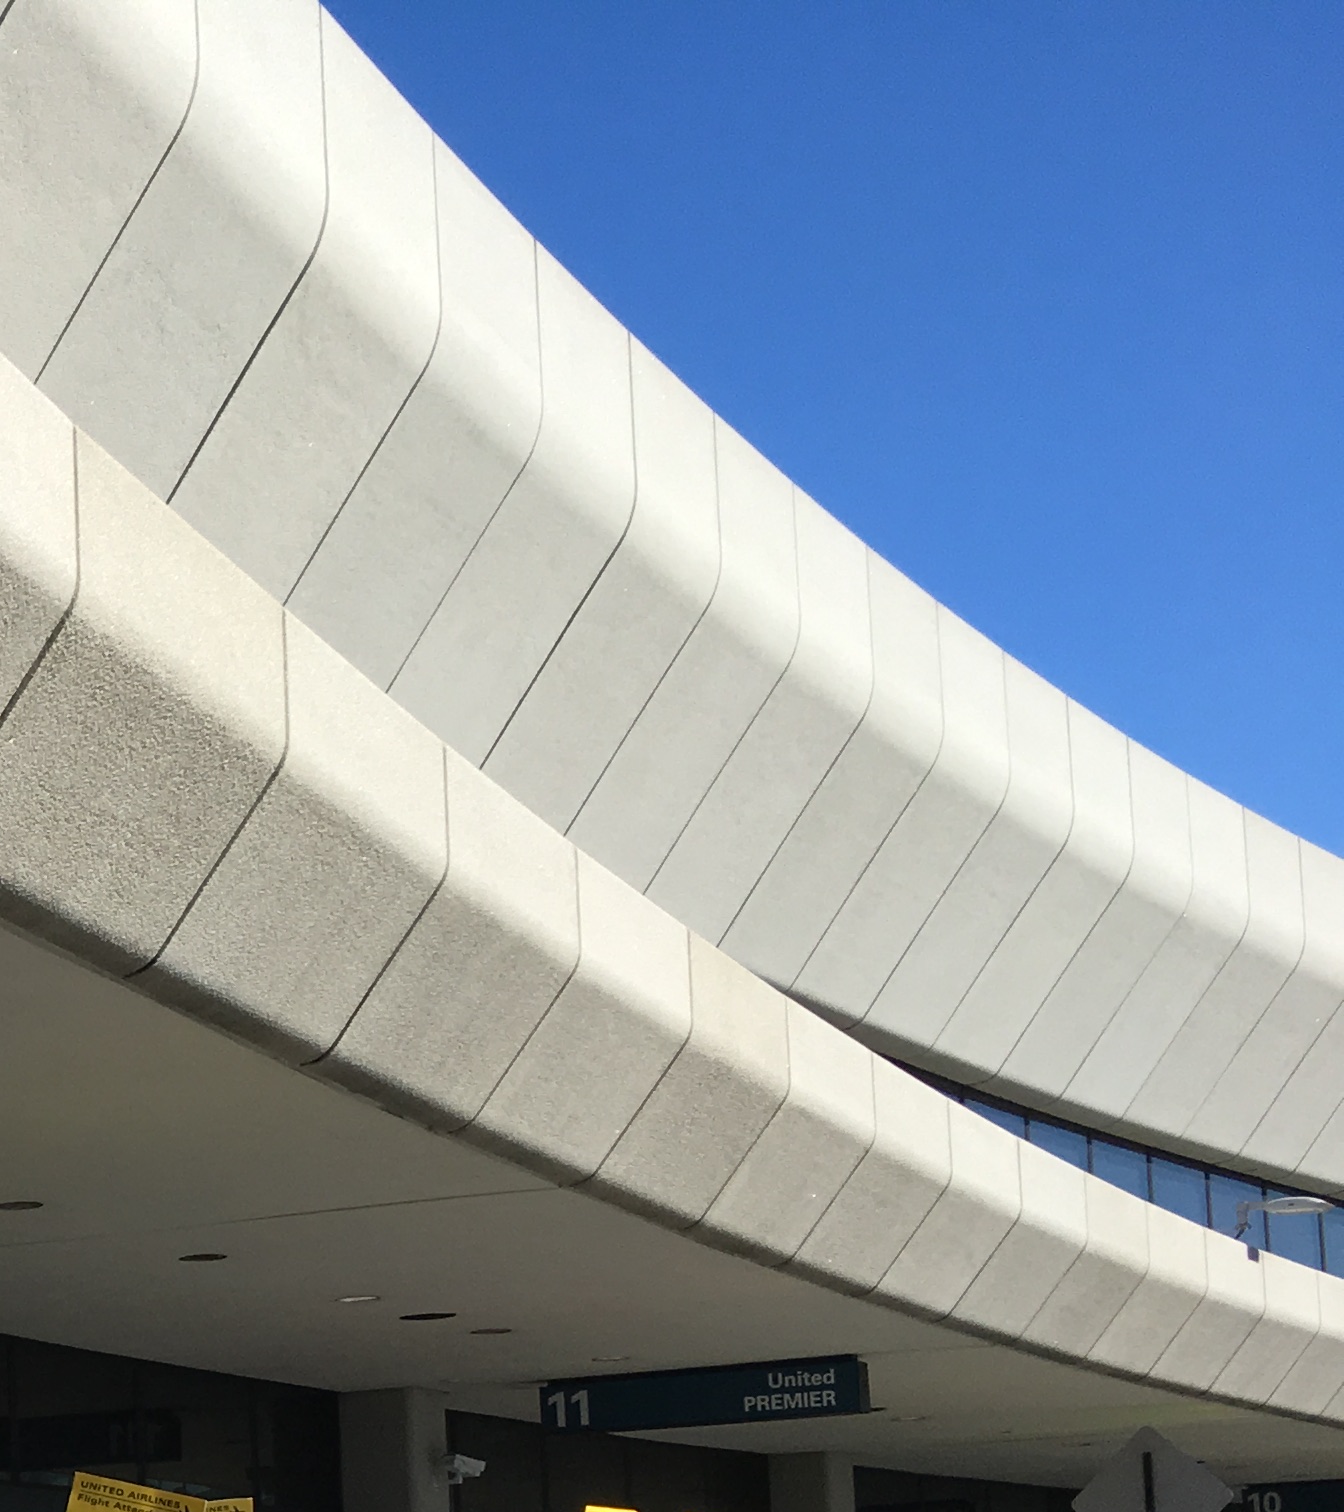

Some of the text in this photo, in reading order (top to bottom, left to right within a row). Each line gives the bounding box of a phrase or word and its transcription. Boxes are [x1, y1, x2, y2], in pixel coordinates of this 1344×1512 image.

[767, 1368, 835, 1389] United
[547, 1389, 590, 1428] 11
[743, 1390, 836, 1412] PREMIER
[77, 1493, 110, 1508] Flight
[80, 1481, 180, 1509] UNITED AIRLINES
